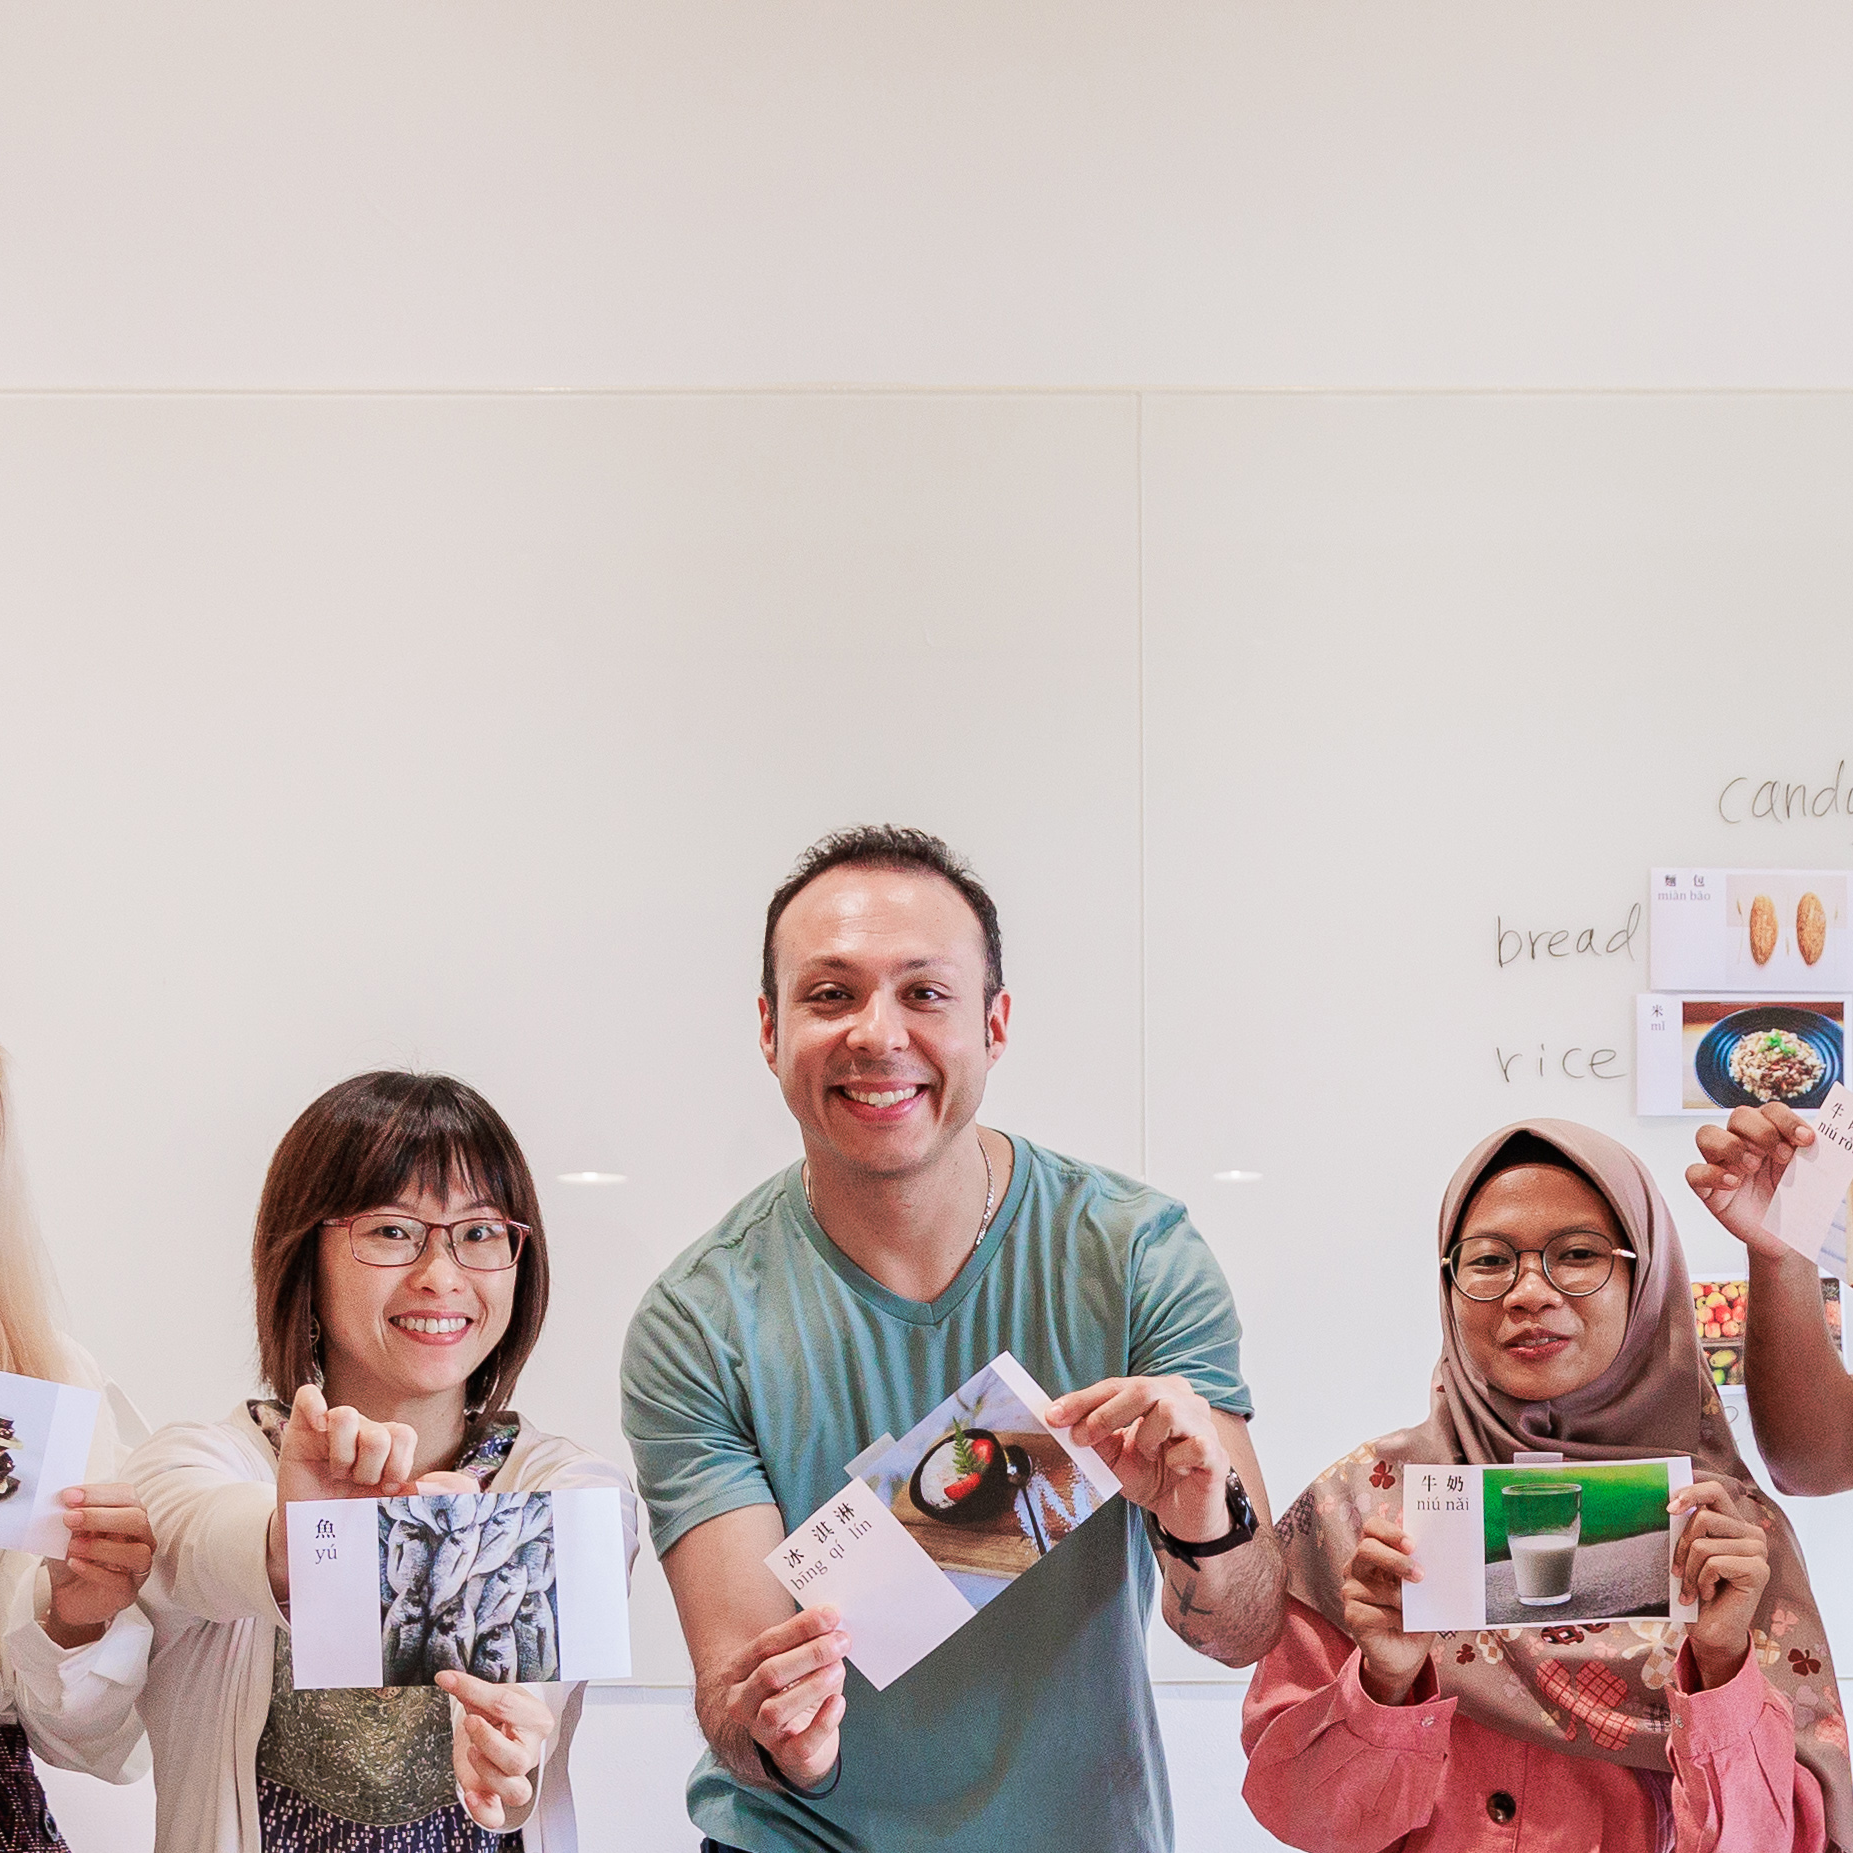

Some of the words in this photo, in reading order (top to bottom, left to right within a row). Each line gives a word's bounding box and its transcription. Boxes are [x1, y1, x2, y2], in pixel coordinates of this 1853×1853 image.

[1497, 902, 1641, 968] bread
[1651, 1004, 1664, 1018] 米
[1496, 1042, 1629, 1083] rice
[1817, 1121, 1838, 1141] niú
[1420, 1474, 1464, 1493] 牛奶
[1416, 1495, 1441, 1511] niú
[1445, 1496, 1470, 1511] nǎi
[314, 1518, 336, 1539] 魚
[783, 1502, 855, 1569] 冰淇淋
[314, 1543, 338, 1565] yú
[790, 1559, 829, 1591] bīng
[848, 1520, 873, 1540] lín
